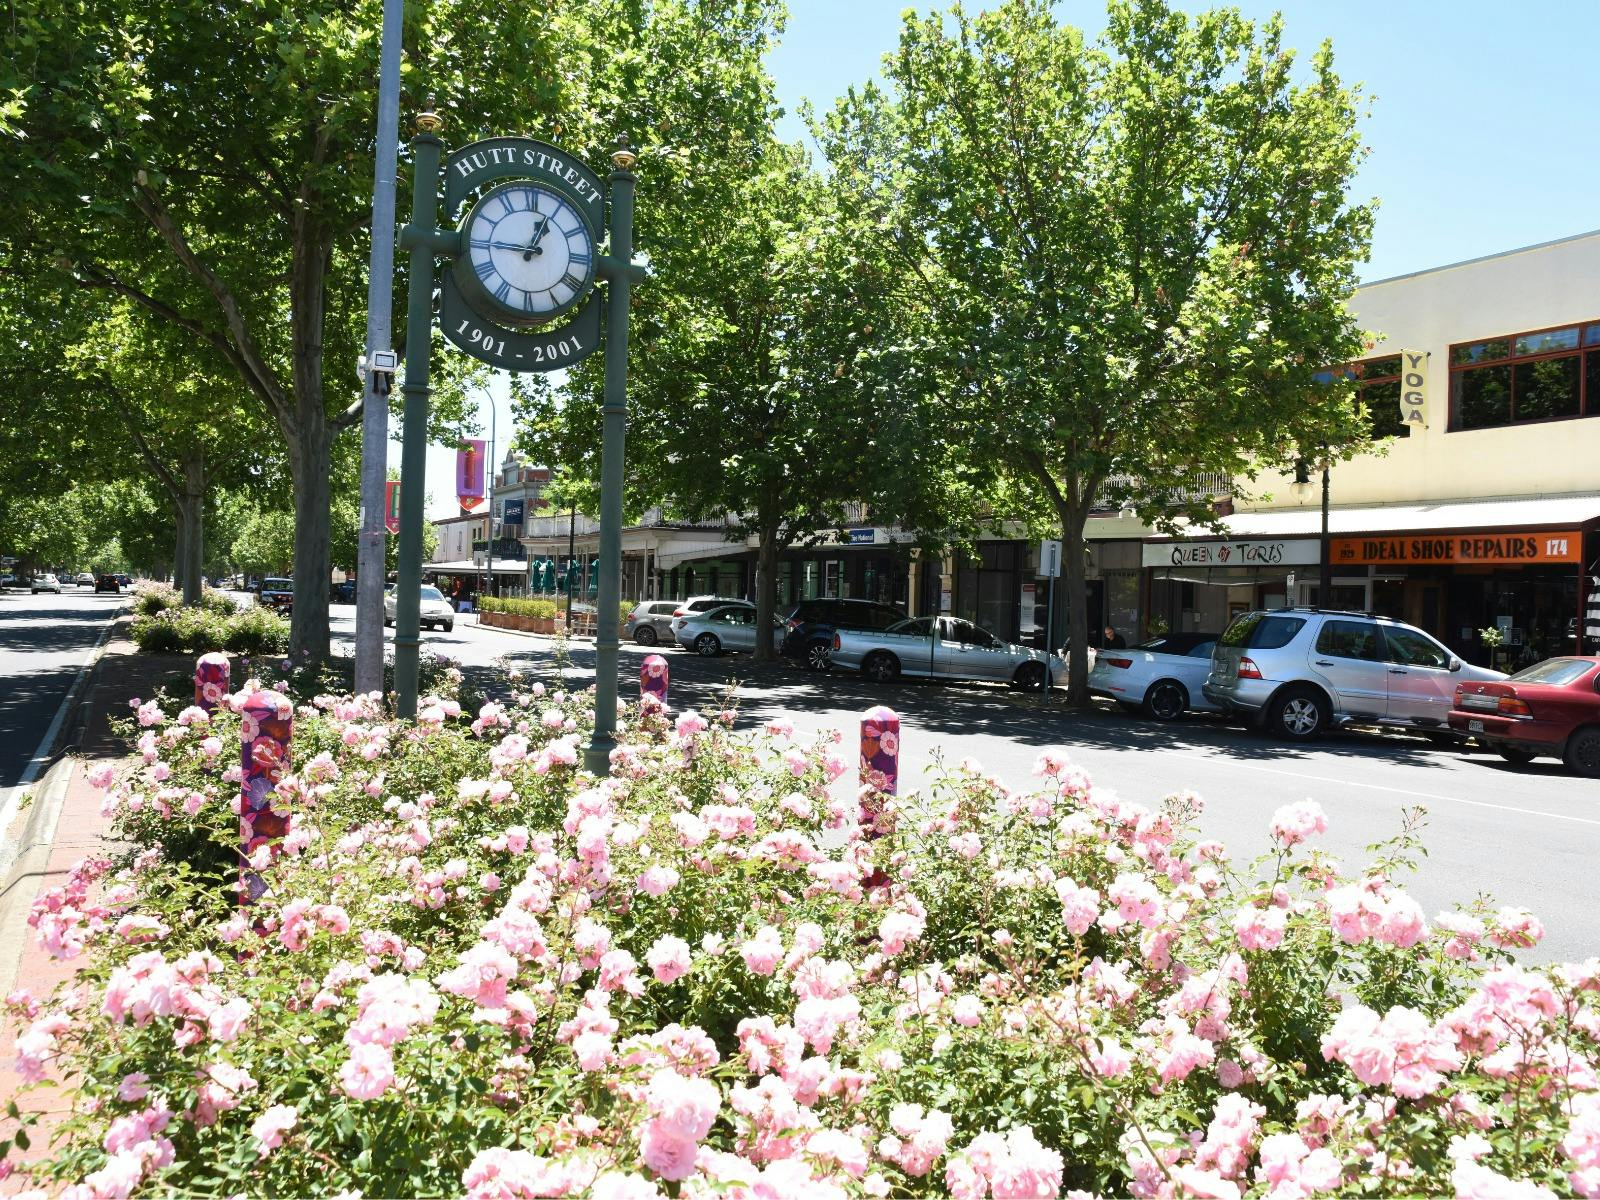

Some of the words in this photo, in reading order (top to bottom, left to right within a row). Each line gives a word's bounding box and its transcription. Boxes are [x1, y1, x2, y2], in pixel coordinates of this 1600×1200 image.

[455, 147, 517, 179] HUTT
[523, 149, 602, 205] STREET
[455, 319, 505, 357] 1901
[533, 335, 583, 362] 2001
[1404, 354, 1424, 424] YOGA
[1363, 541, 1407, 560] IDEAL
[1411, 539, 1454, 560] SHOE
[1460, 537, 1538, 559] REPAIRS
[1546, 539, 1568, 556] 174
